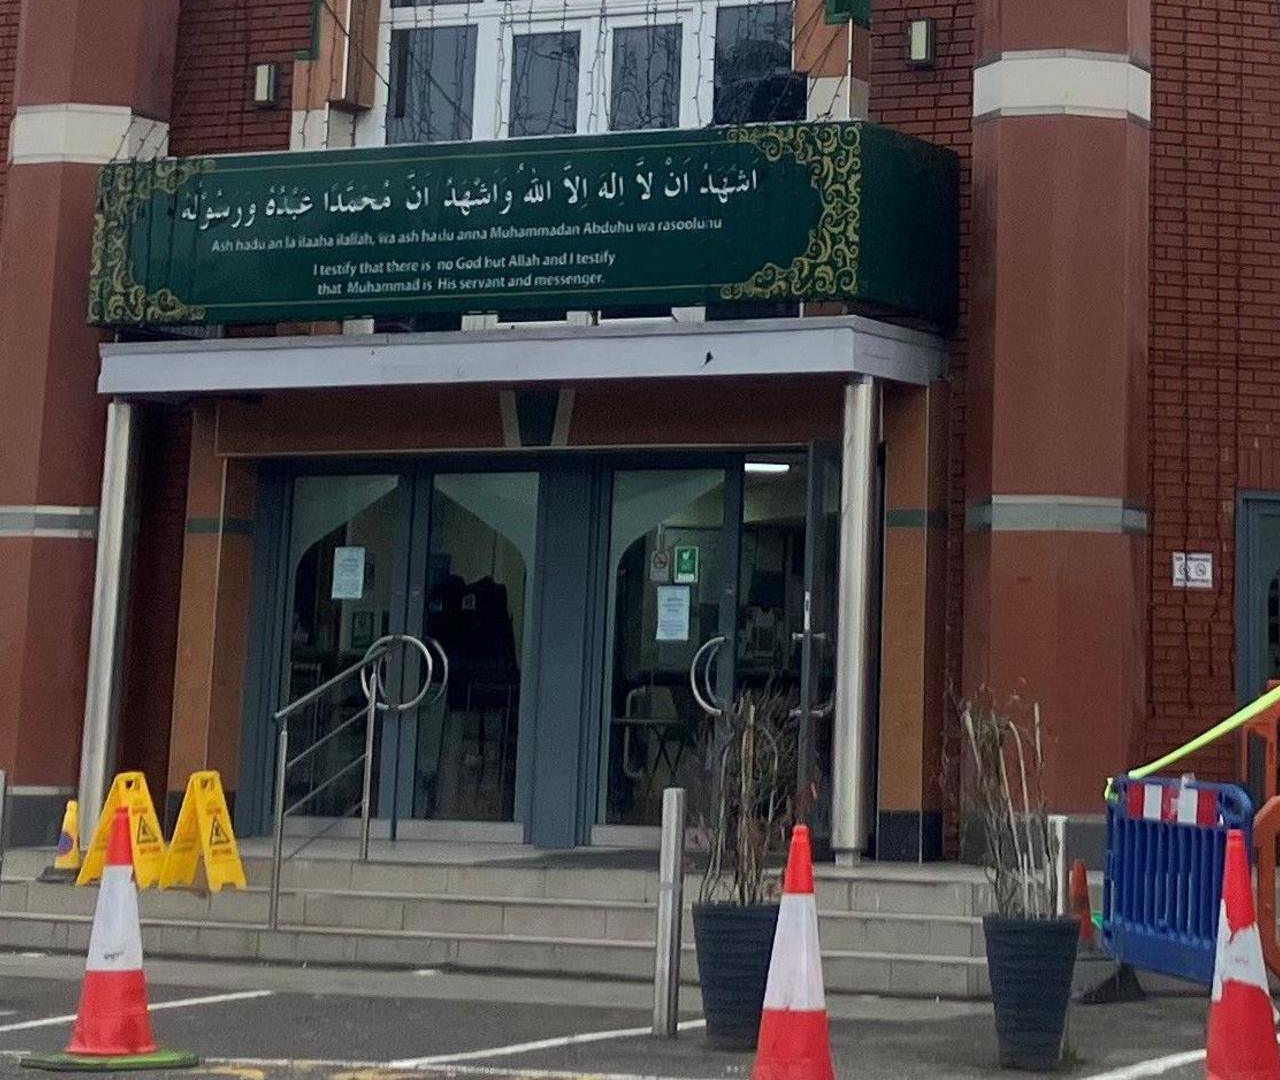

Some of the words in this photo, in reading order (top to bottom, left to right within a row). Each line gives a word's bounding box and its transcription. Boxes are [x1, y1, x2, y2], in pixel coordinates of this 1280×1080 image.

[211, 239, 234, 252] Ash
[267, 239, 283, 250] an
[398, 230, 419, 244] ash
[457, 229, 488, 241] anna
[489, 223, 581, 239] Muhammadan
[583, 221, 634, 235] Abduhu
[636, 221, 655, 232] wa
[320, 261, 358, 277] testify
[360, 261, 385, 274] that
[386, 259, 419, 273] there
[421, 260, 431, 271] is
[437, 260, 454, 270] no
[456, 256, 482, 270] God
[484, 255, 506, 268] but
[508, 253, 540, 267] Allah
[542, 252, 567, 266] and
[576, 250, 616, 267] testify
[317, 282, 343, 295] that
[347, 278, 420, 293] Muhammad
[422, 279, 433, 291] is
[438, 277, 457, 290] His
[459, 275, 506, 289] servant
[507, 274, 532, 287] and
[534, 273, 605, 288] messenger.
